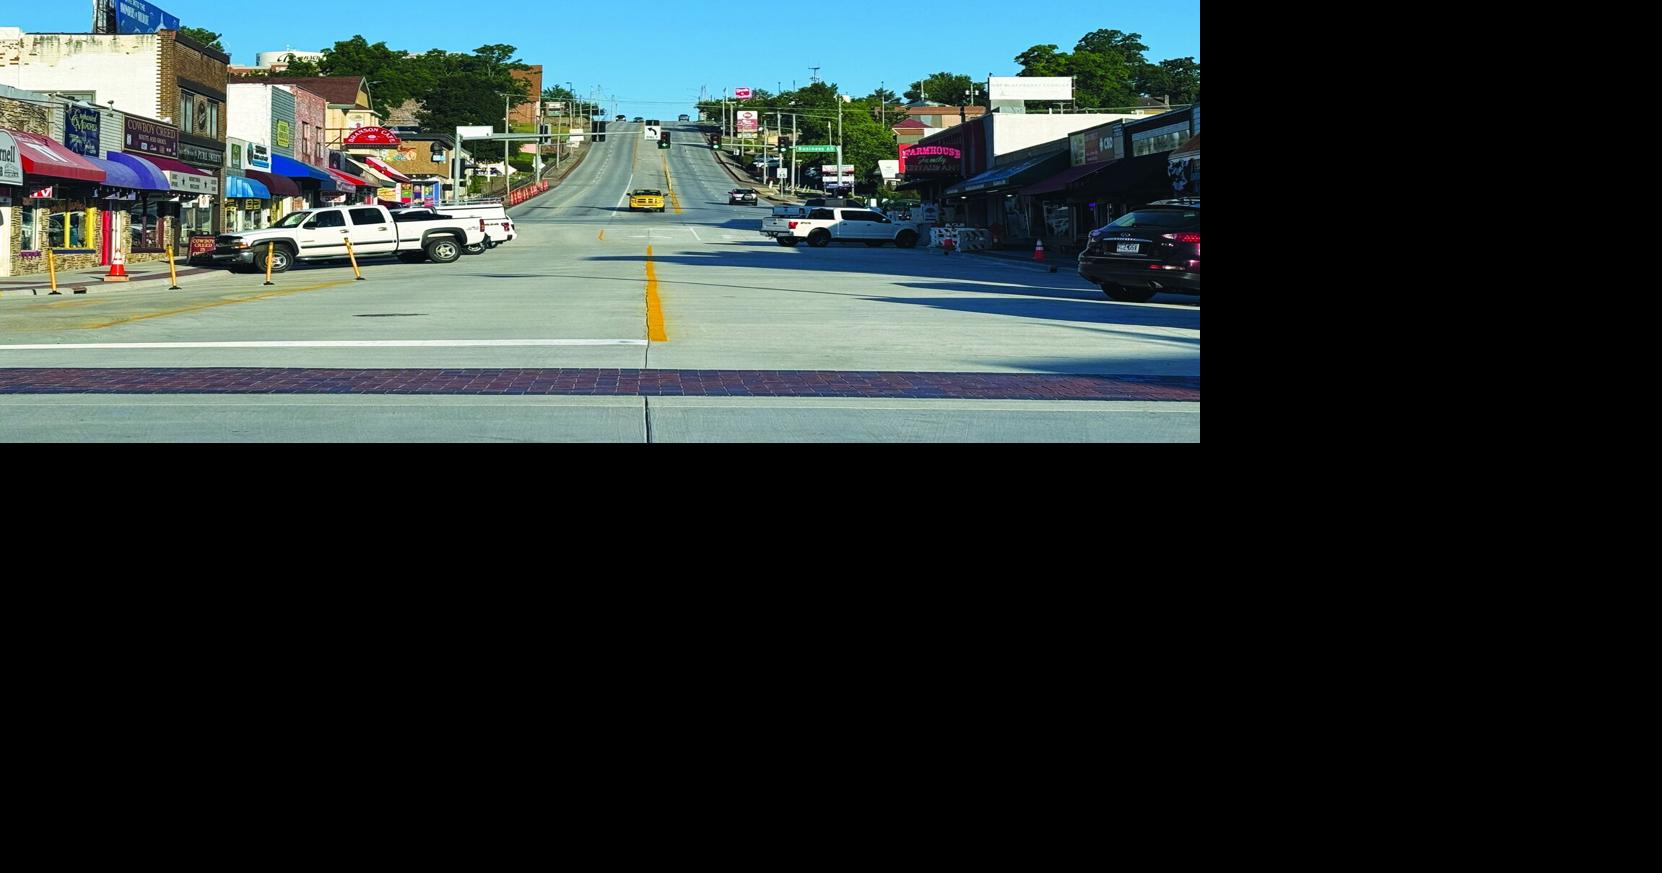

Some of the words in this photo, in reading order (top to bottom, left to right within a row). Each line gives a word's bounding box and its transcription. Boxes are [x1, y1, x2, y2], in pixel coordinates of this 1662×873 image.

[127, 119, 156, 135] COWBOY
[155, 125, 176, 138] CREED
[348, 127, 379, 143] BRANSON
[381, 130, 396, 143] CAFE
[902, 146, 961, 159] FARMHOUSE
